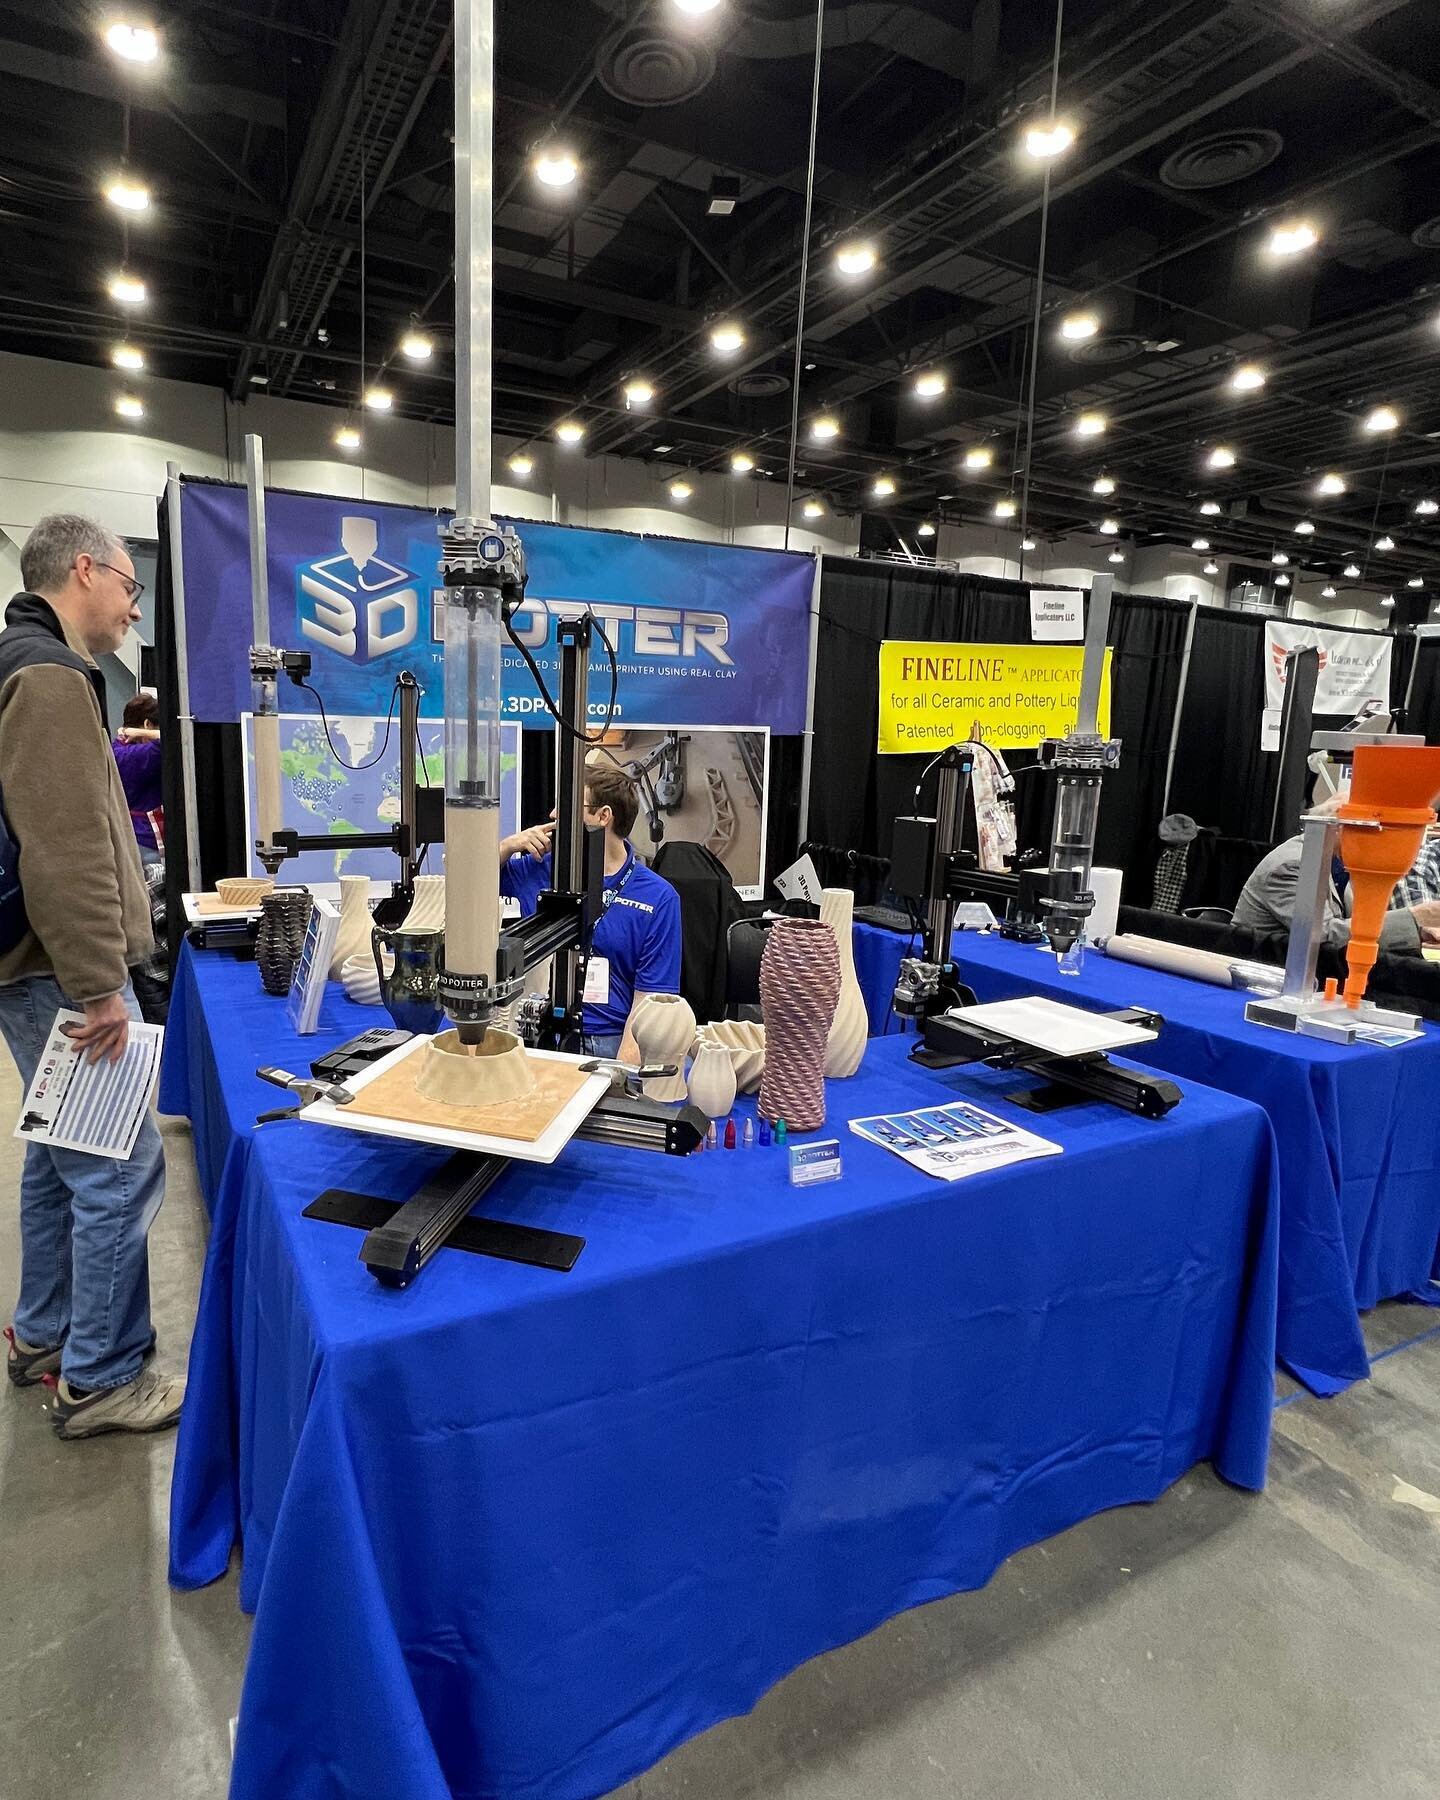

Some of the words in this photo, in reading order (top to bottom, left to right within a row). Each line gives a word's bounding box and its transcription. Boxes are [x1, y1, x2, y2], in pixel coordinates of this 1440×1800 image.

[1043, 602, 1065, 611] Fineline
[301, 574, 418, 660] 3D
[616, 665, 655, 675] PRINTER
[658, 667, 688, 677] USING
[690, 668, 712, 678] REAL
[715, 669, 738, 679] CLAY
[901, 657, 1004, 682] FINELINE
[891, 693, 907, 709] for
[913, 694, 928, 709] all
[932, 693, 985, 709] Ceramic
[989, 693, 1011, 708] and
[1015, 693, 1057, 711] Pottery
[896, 723, 955, 738] Patented
[970, 721, 1046, 740] on-clogging
[448, 979, 483, 988] POTTER
